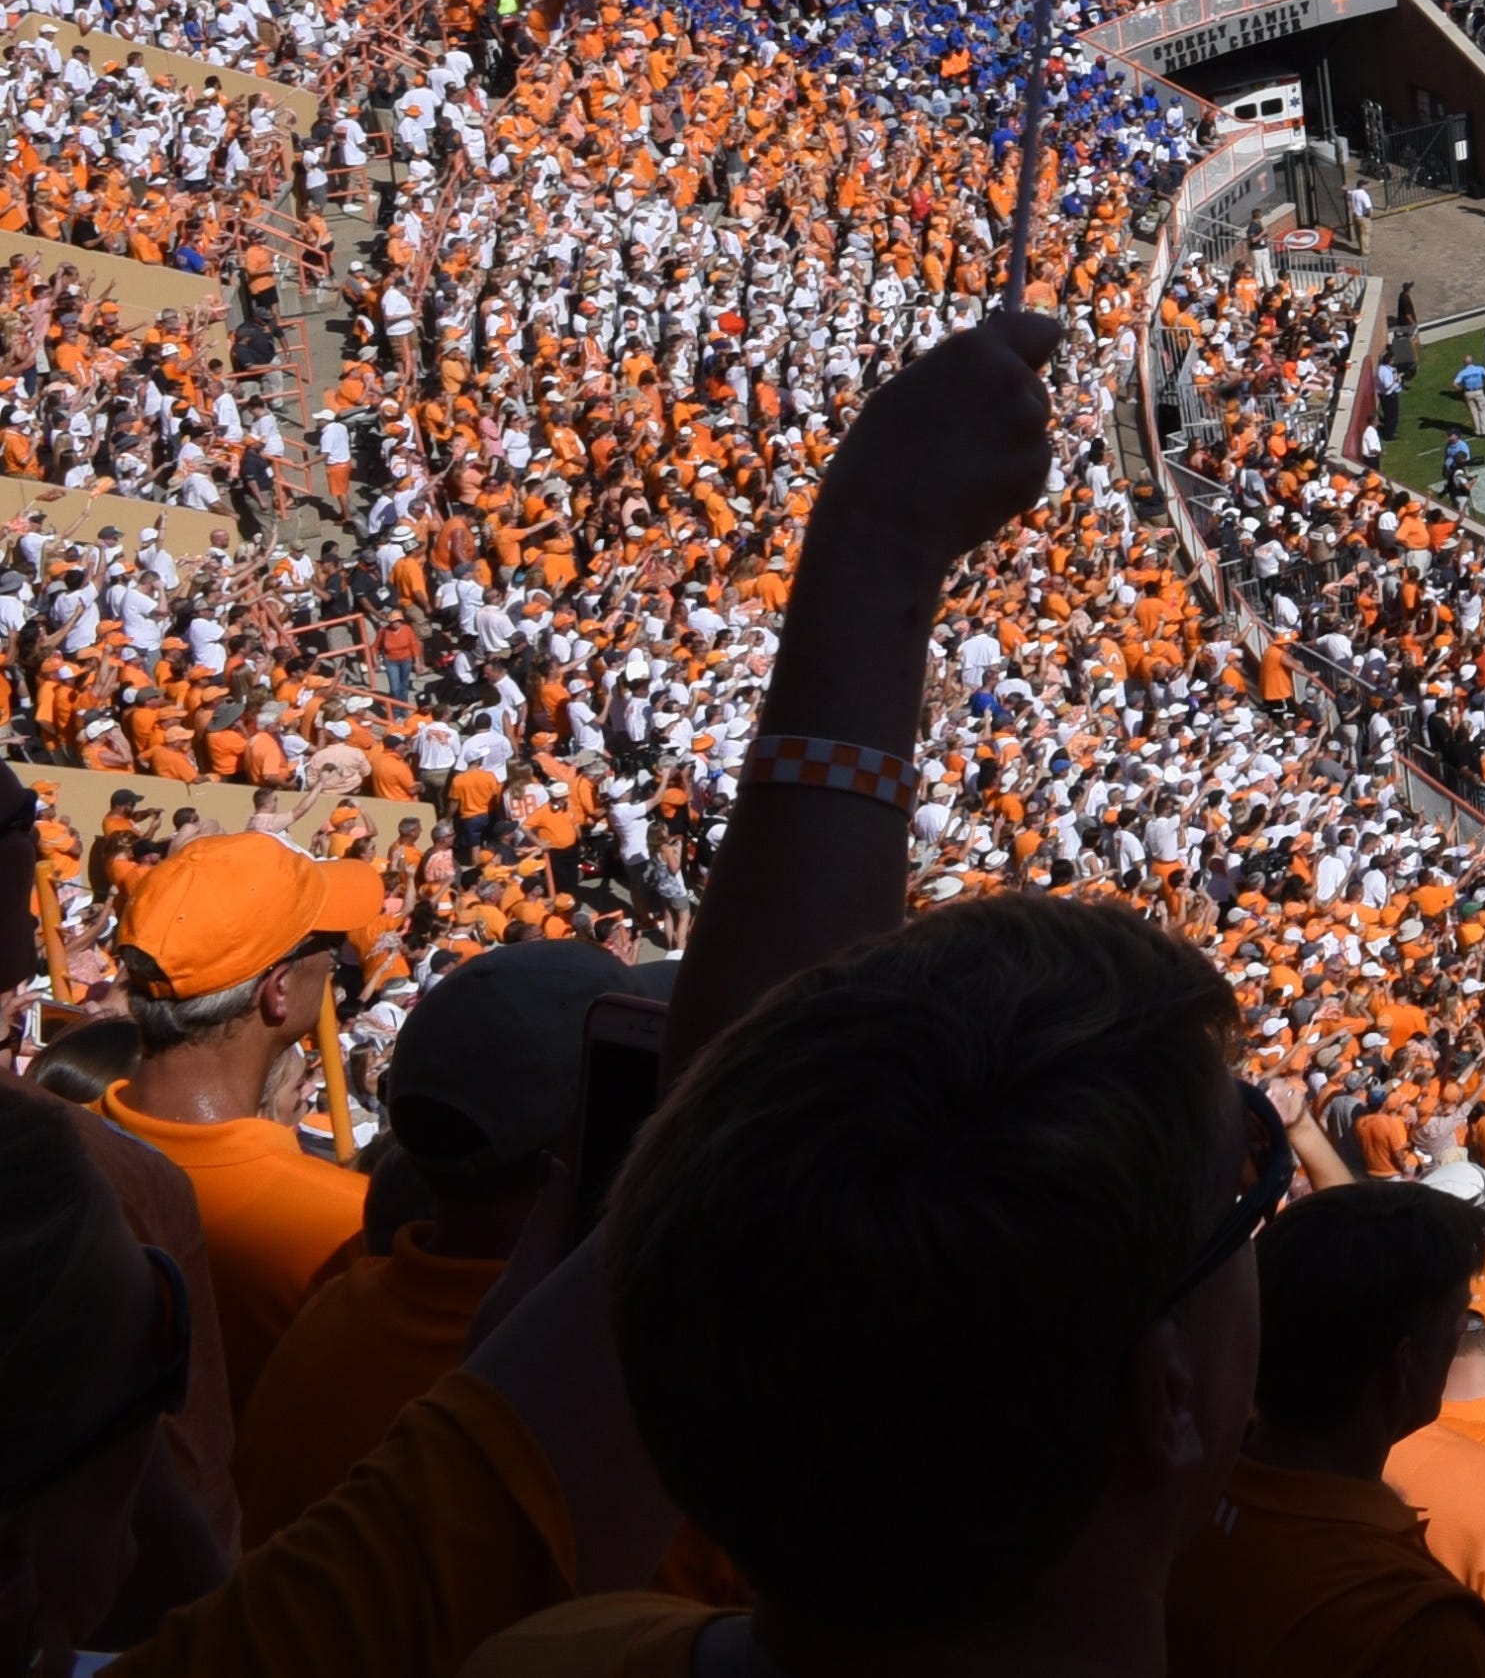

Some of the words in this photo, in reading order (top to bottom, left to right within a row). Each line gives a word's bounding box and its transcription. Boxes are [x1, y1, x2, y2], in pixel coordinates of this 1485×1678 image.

[1153, 24, 1227, 61] STOKELY
[1239, 0, 1311, 32] FAMILY
[1165, 44, 1218, 73] MEDIA
[1229, 17, 1302, 50] CENTER
